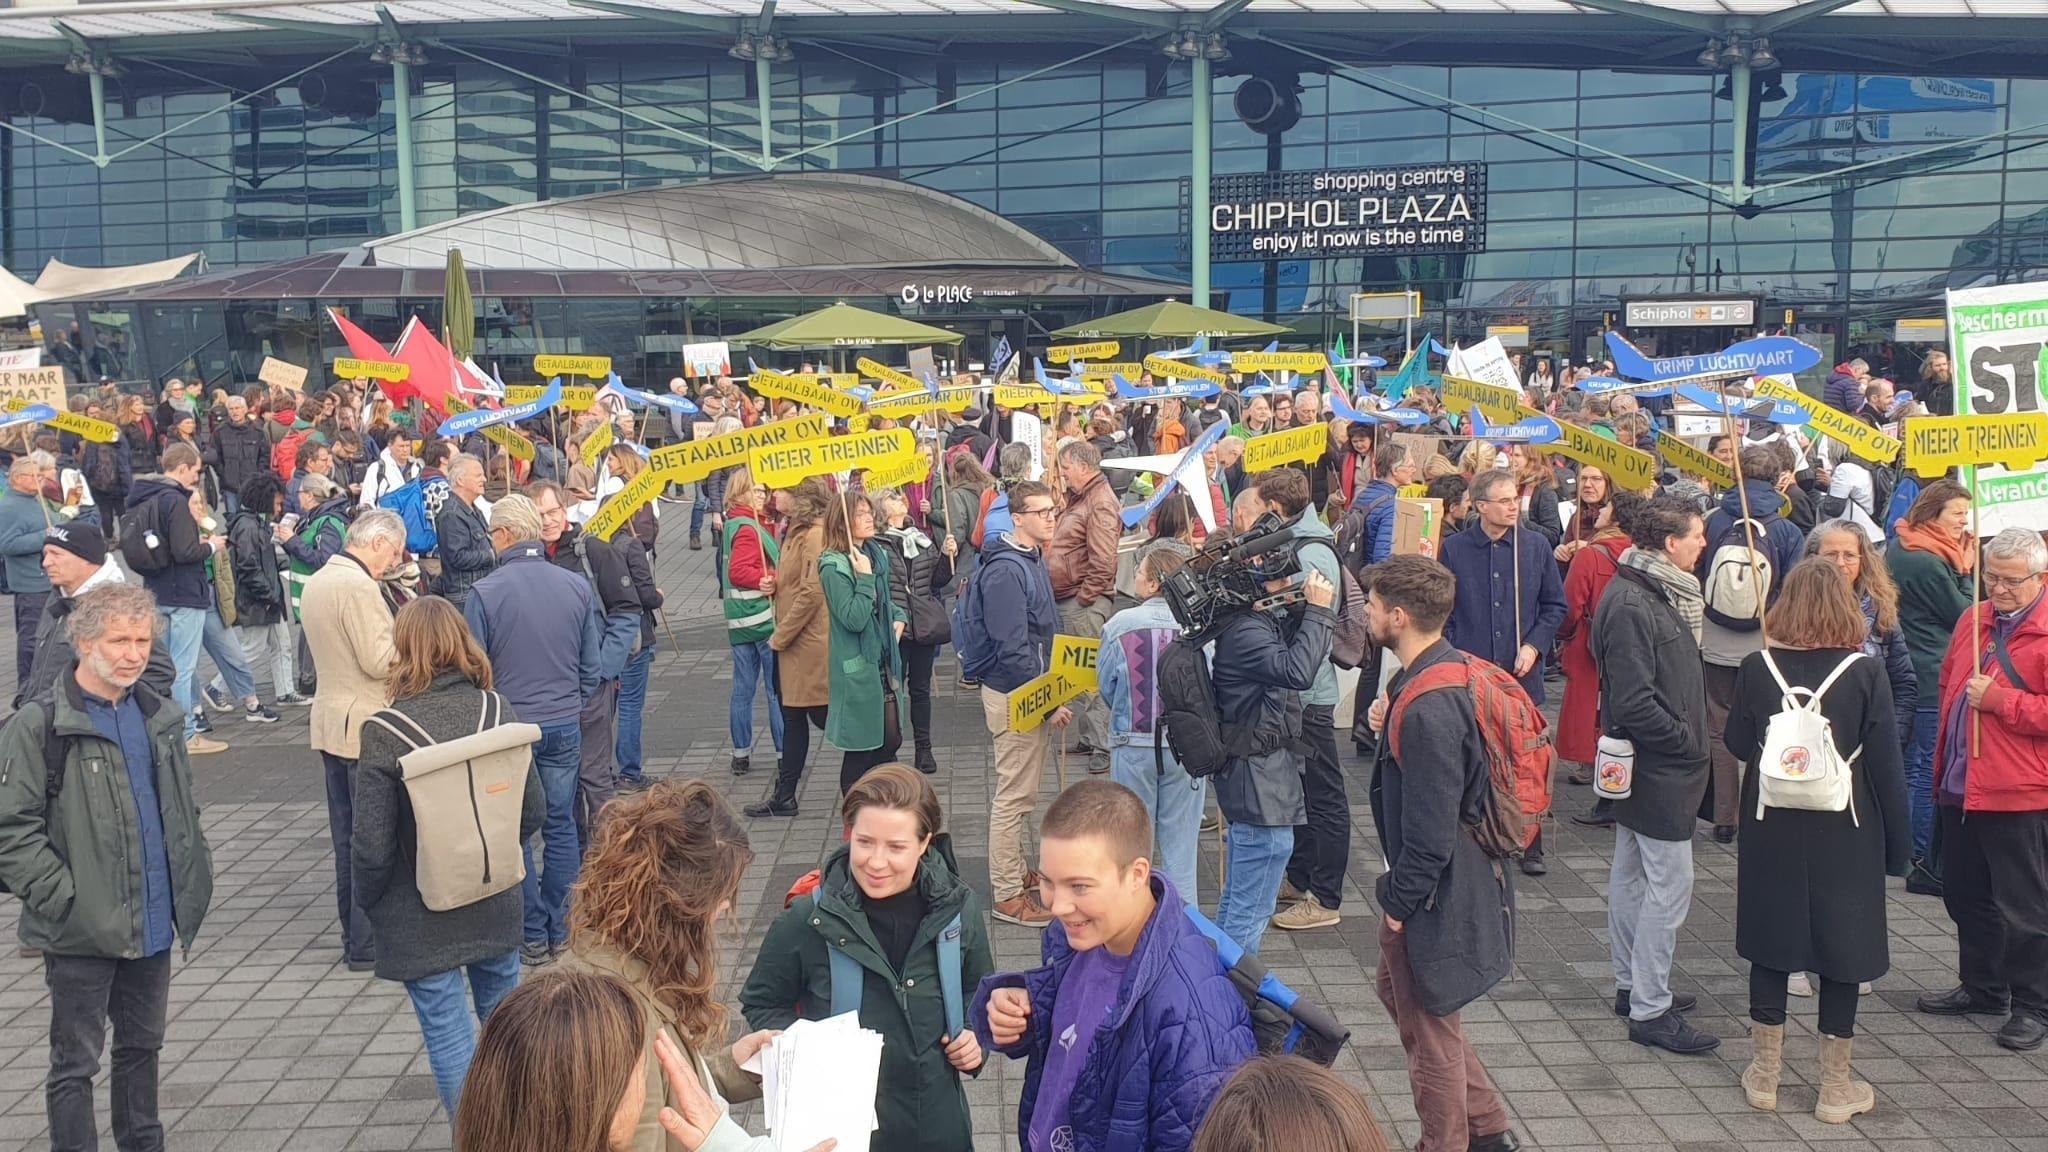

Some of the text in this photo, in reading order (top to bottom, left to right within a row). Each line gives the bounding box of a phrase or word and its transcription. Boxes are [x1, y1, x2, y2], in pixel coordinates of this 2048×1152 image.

[1313, 169, 1465, 193] shopping centre
[1212, 193, 1471, 232] CHIPHOL PLAZA
[1252, 226, 1464, 254] enjoy it! now is the time
[923, 285, 934, 303] La
[938, 284, 973, 303] PLACE
[1631, 307, 1692, 322] Schiphol
[336, 359, 402, 374] MEER TREINEN
[1232, 354, 1304, 365] BETAALBAAR
[1307, 355, 1324, 365] OV
[1653, 350, 1794, 375] KRIMP LUCHTVAART
[18, 370, 58, 386] NAAR
[1970, 342, 2042, 414] ST
[579, 391, 594, 401] OV
[750, 374, 837, 404] BETAALBAAR
[840, 397, 860, 410] OV
[999, 388, 1034, 399] MEER
[1442, 379, 1518, 412] BETAALBAAR OV
[450, 403, 537, 431] KRIMP LUCHTVAART
[95, 425, 114, 437] OV
[1913, 422, 2037, 456] MEER TREINEN
[649, 426, 787, 473] BETAALBAAR
[795, 417, 823, 440] OV
[759, 433, 900, 473] MEER TREINEN
[1246, 431, 1311, 465] BETAALBAAR
[1871, 436, 1898, 454] OV
[1624, 454, 1649, 477] OV
[614, 472, 656, 515] TREINE
[1062, 645, 1098, 670] ME
[1016, 683, 1052, 723] MEER
